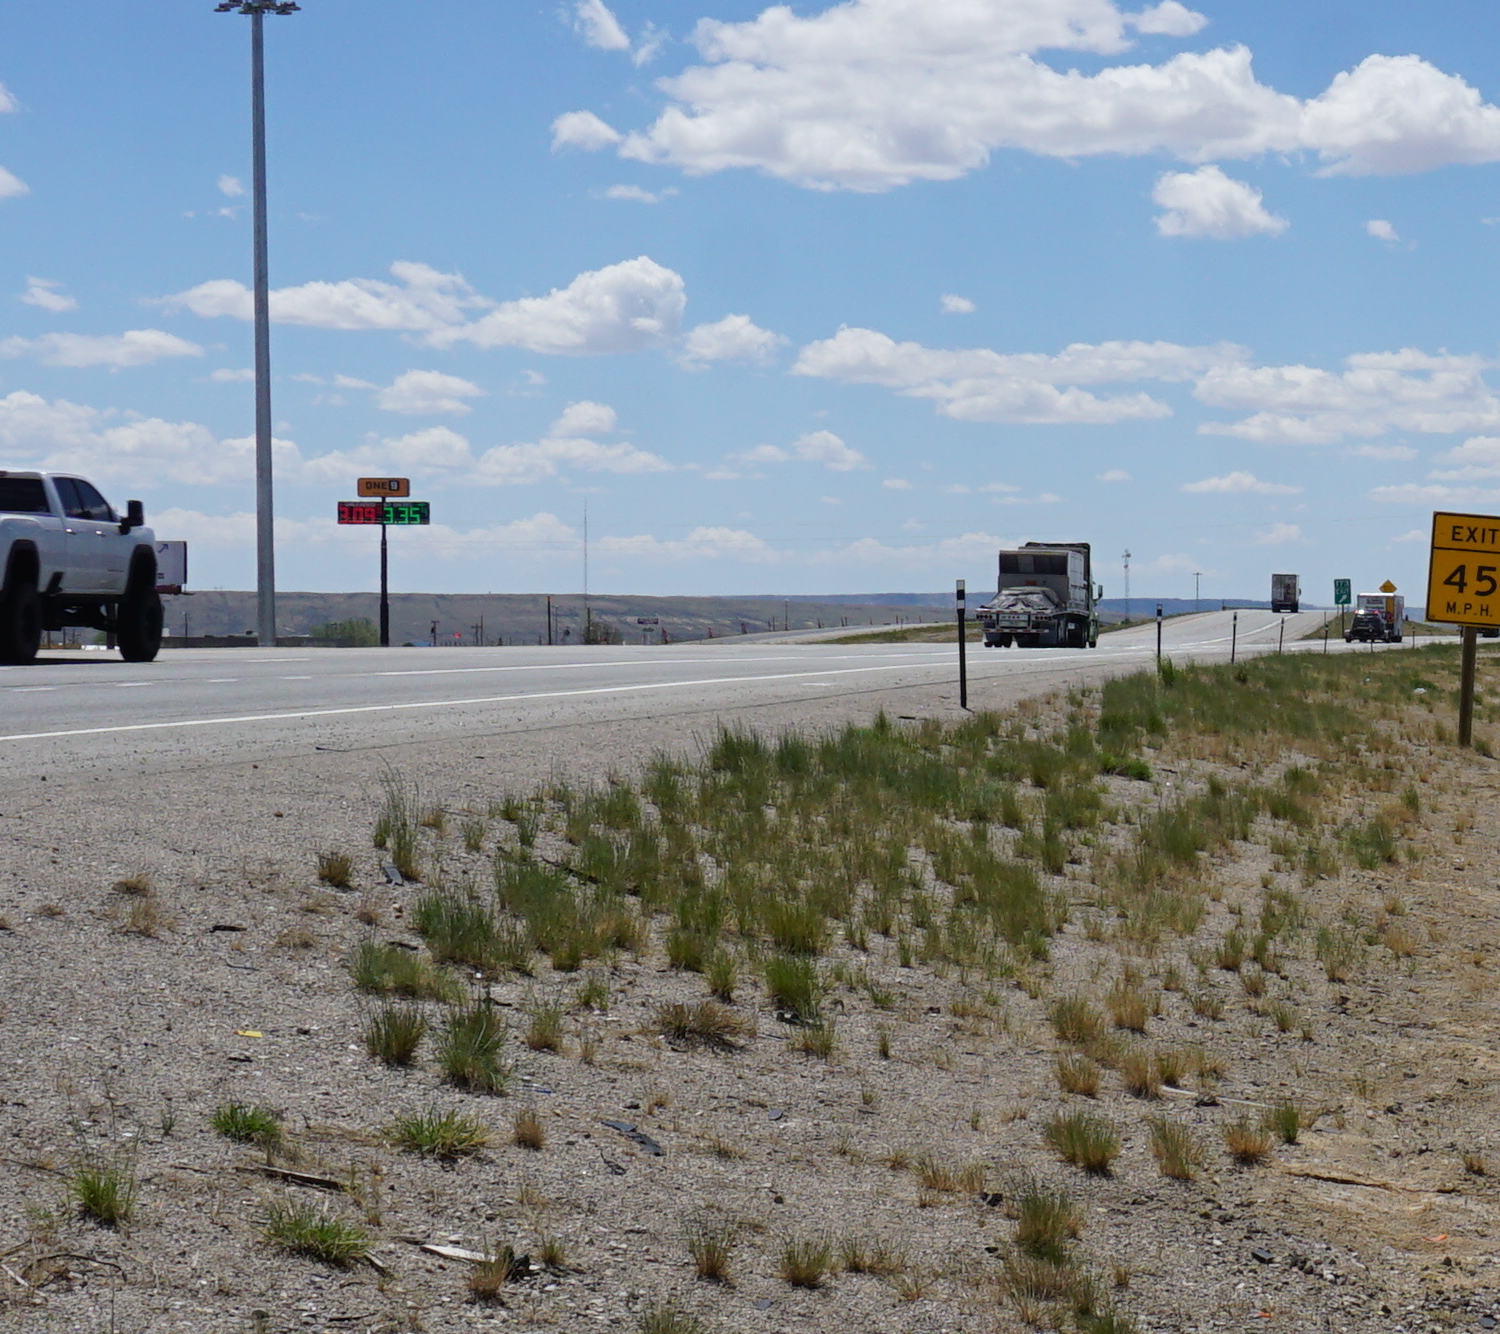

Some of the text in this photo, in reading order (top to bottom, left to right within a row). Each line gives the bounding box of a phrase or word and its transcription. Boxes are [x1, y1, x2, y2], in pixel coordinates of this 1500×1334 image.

[1451, 525, 1500, 545] EXIT
[1443, 564, 1498, 597] 45
[1446, 601, 1494, 618] M.P.H.
